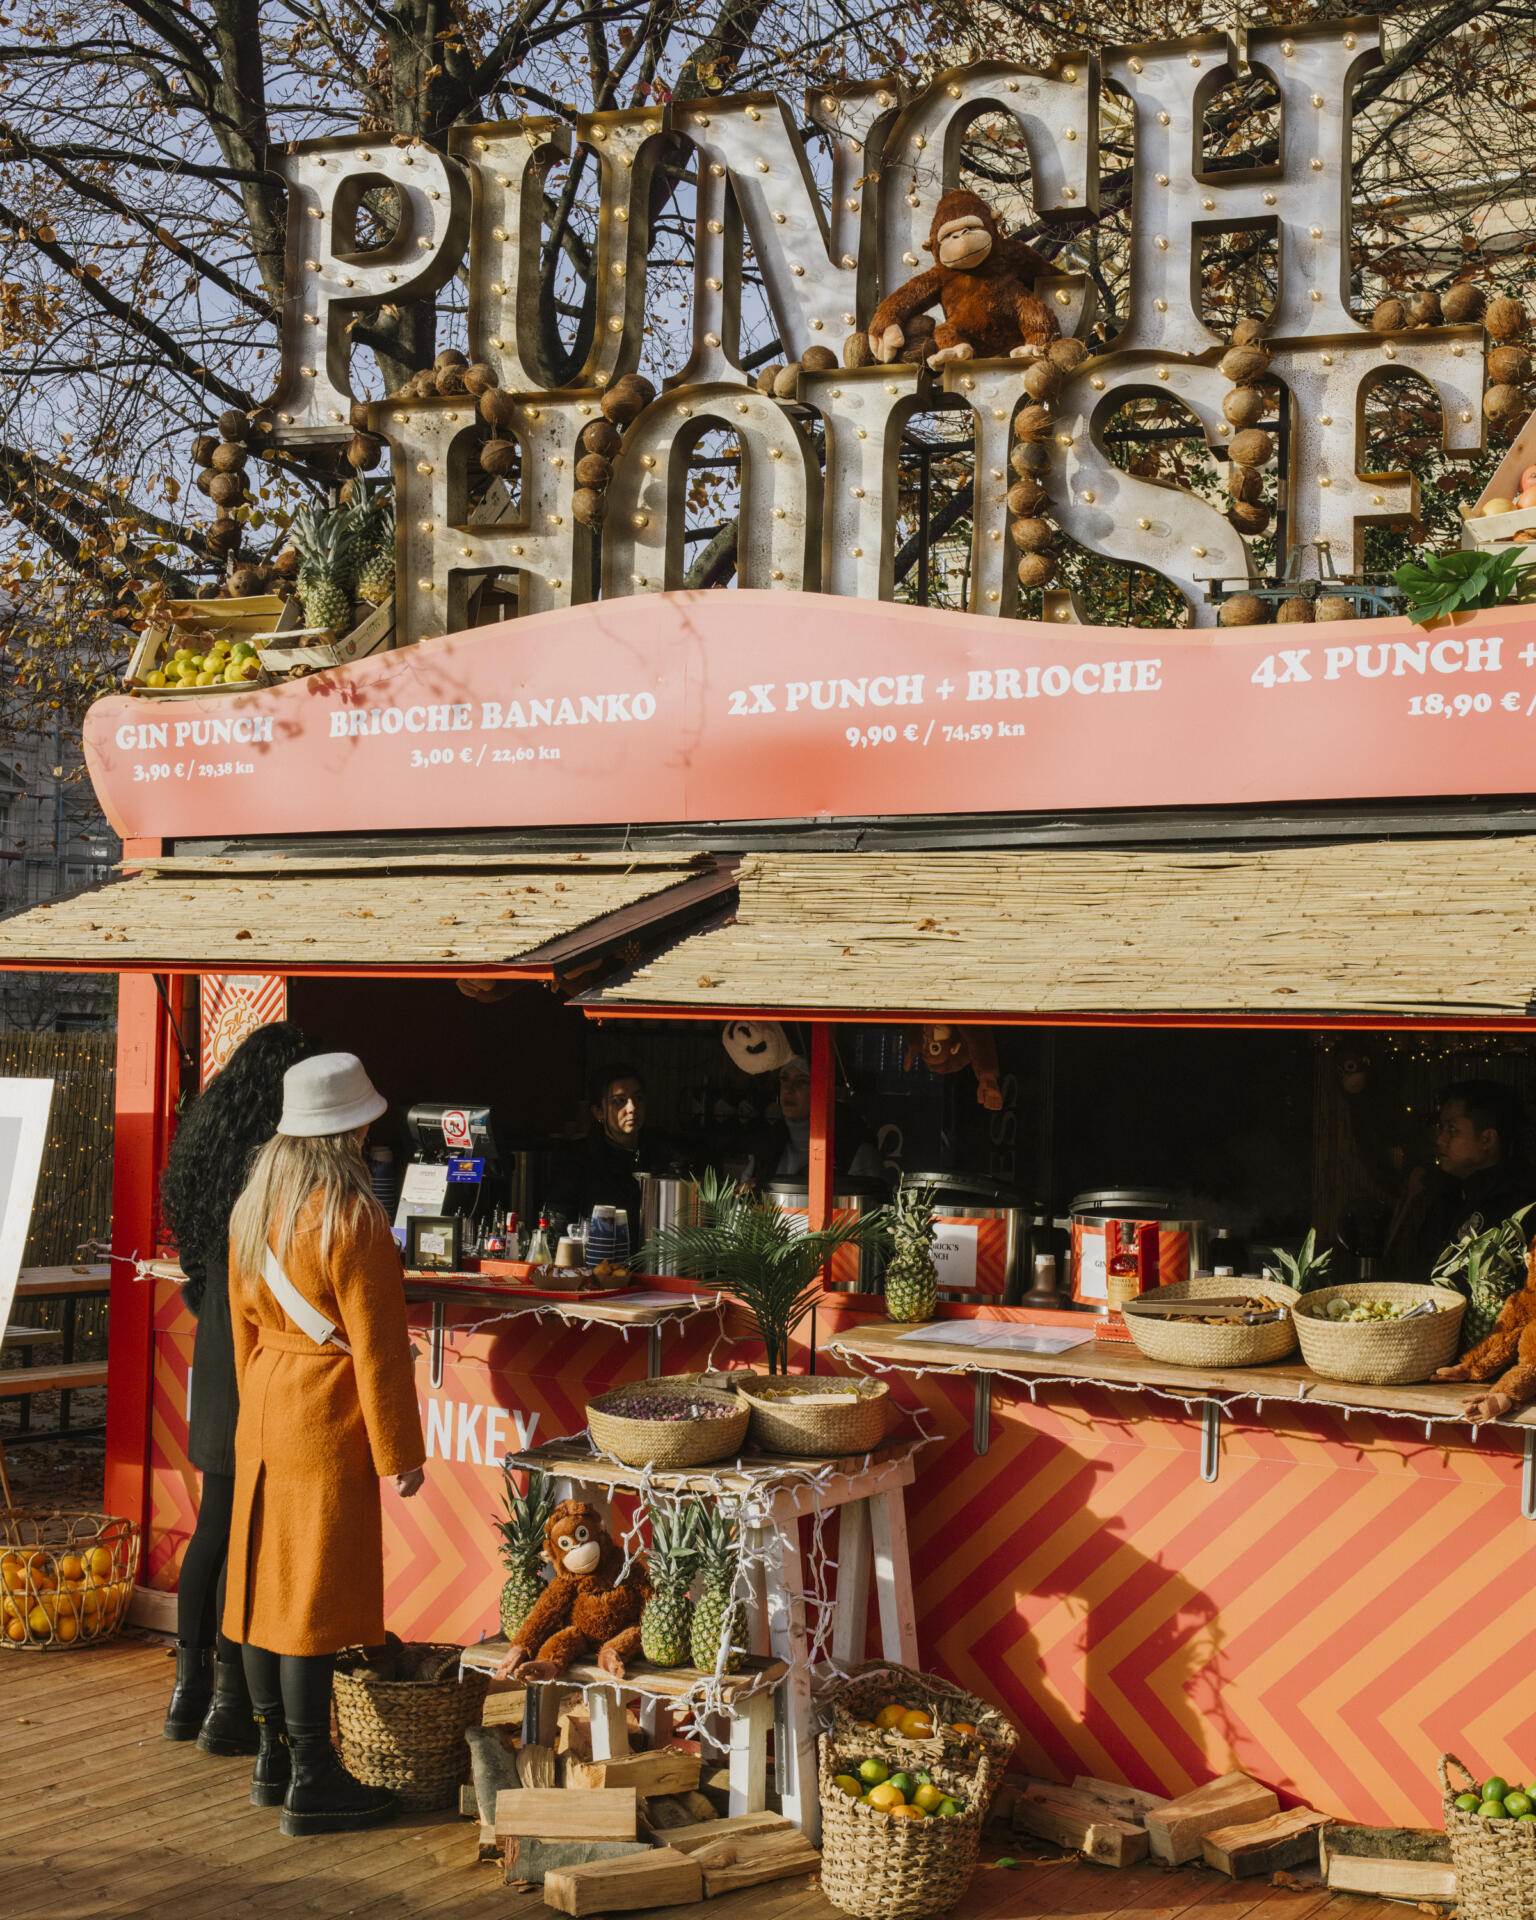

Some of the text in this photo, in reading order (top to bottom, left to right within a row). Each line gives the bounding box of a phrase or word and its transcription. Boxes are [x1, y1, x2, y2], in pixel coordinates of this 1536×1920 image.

[267, 15, 1382, 446] PUNCH
[369, 324, 1488, 648] HOUSE
[1250, 648, 1313, 689] 4X
[1323, 637, 1504, 681] PUNCH
[727, 658, 1163, 716] 2X PUNCH + BRIOCHE
[1407, 693, 1492, 719] 18,90
[115, 715, 275, 751] GIN PUNCH
[328, 691, 657, 738] BRIOCHE BANANKO
[845, 724, 898, 748] 9,90
[941, 723, 994, 743] 74,59
[997, 721, 1026, 738] kn
[133, 763, 171, 783] 3,90
[197, 762, 233, 778] 29,38
[235, 760, 255, 775] kn
[409, 747, 455, 769] 3,00
[491, 746, 536, 764] 22,60
[538, 744, 561, 761] kn
[932, 1243, 960, 1252] RICK'S
[417, 1397, 542, 1468] NKEY
